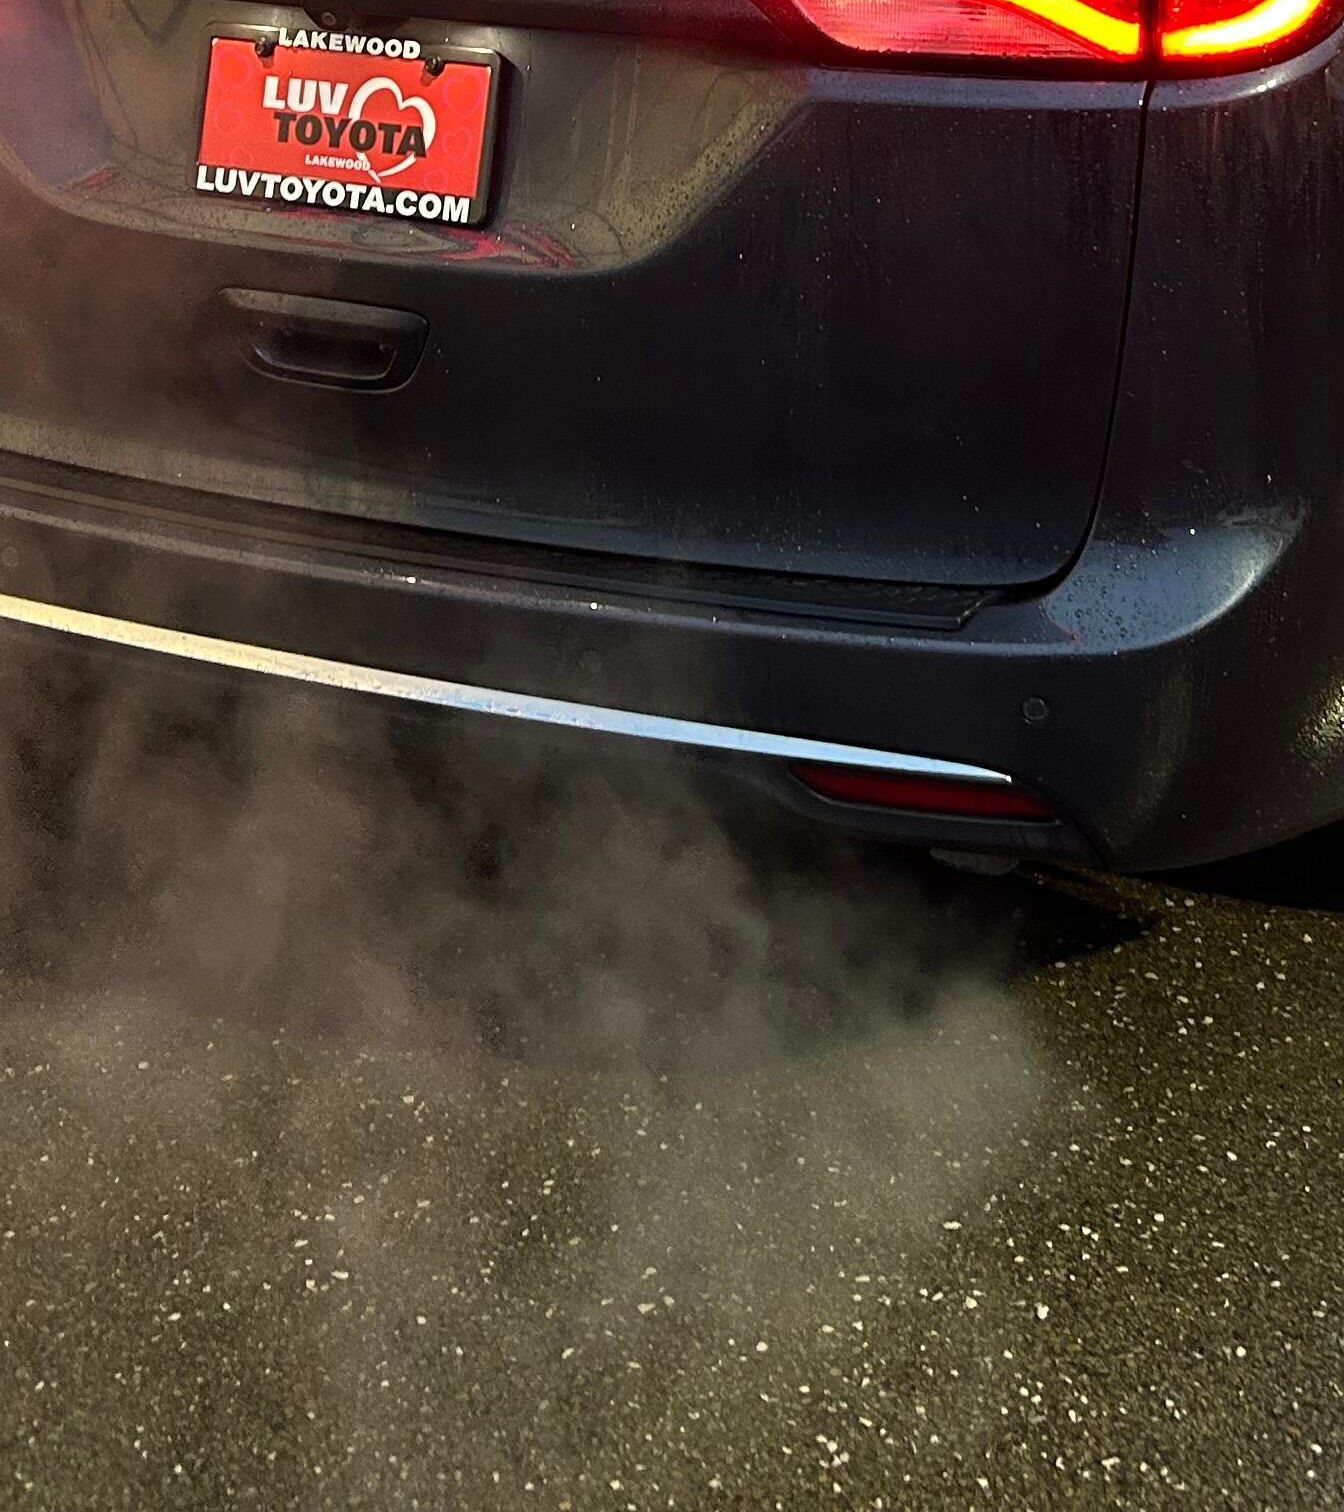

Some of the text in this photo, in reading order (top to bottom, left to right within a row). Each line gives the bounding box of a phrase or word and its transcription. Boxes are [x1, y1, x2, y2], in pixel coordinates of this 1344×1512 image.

[278, 27, 421, 59] LAKEWOOD
[262, 75, 348, 115] LUV
[273, 112, 427, 157] TOYOTA
[304, 154, 371, 172] LAKEWOOD
[196, 165, 471, 224] LUVTOYOTA.COM
